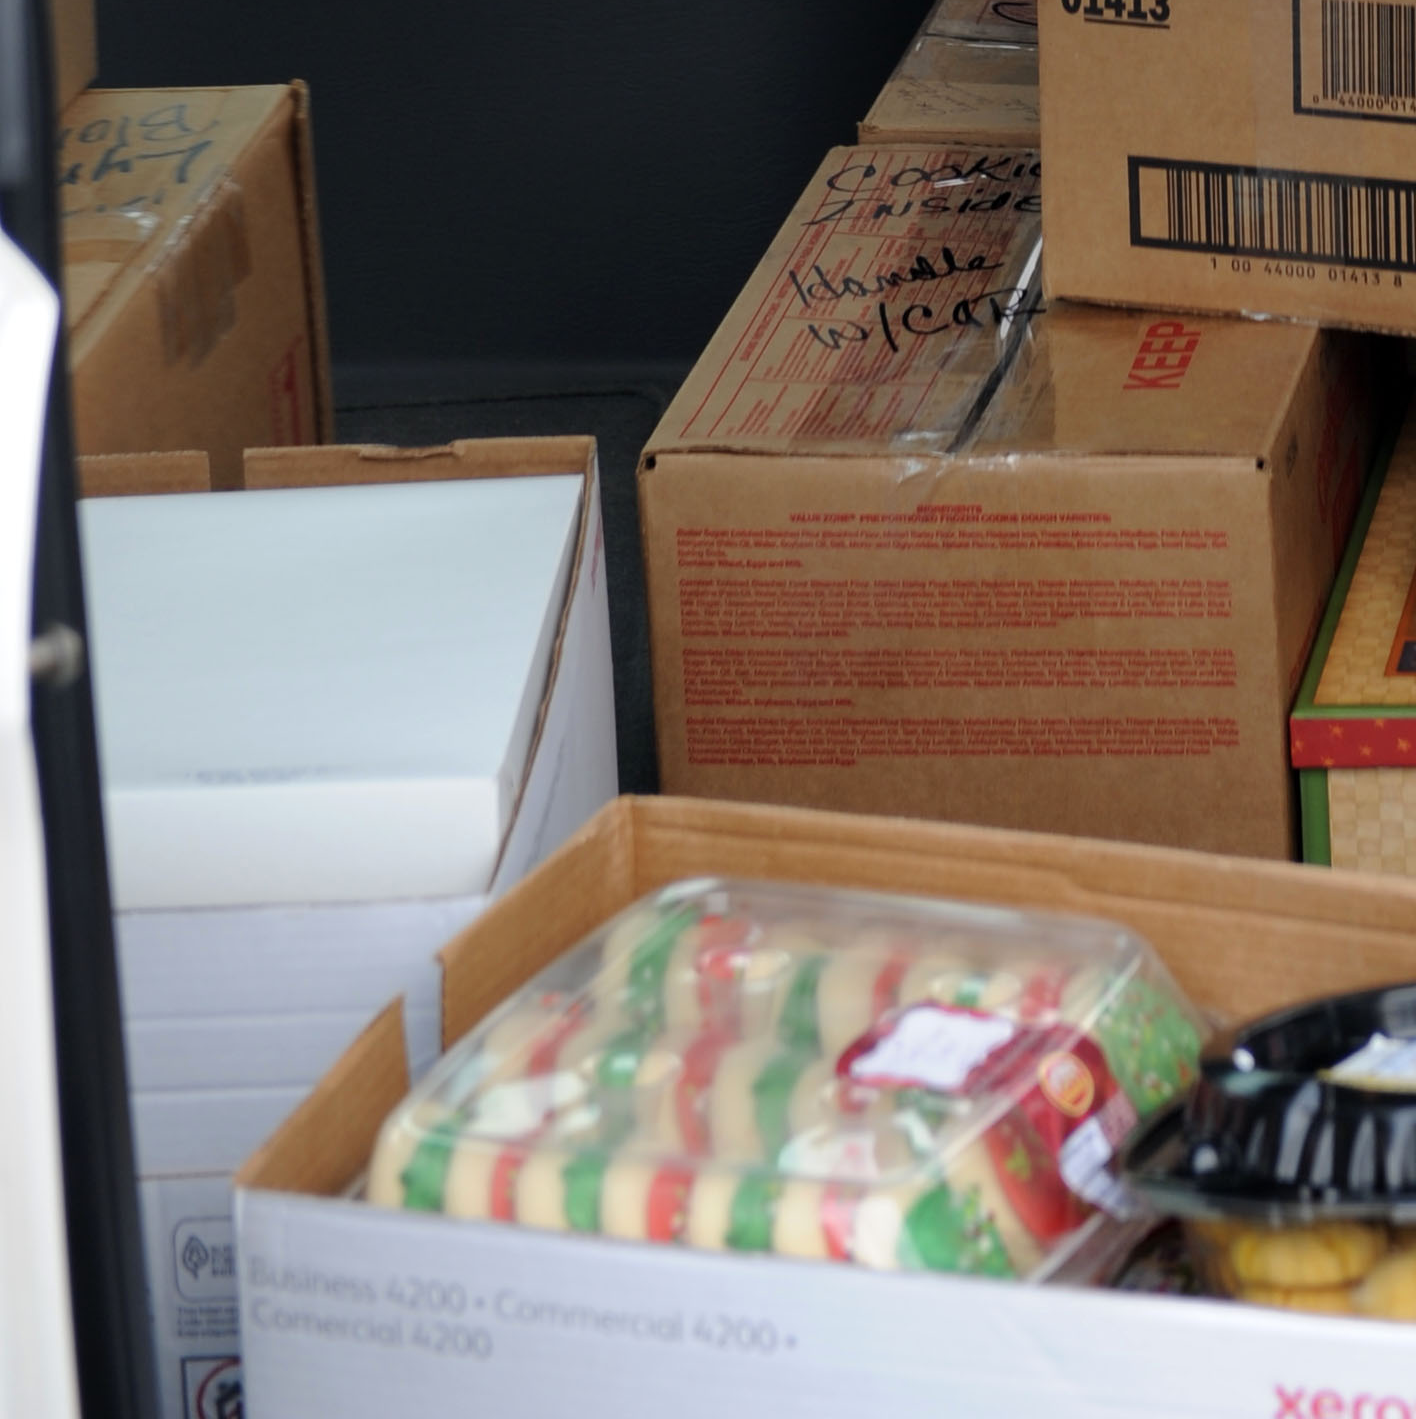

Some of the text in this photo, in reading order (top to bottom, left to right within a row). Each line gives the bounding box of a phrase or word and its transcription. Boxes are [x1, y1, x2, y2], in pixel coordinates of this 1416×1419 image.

[1338, 95, 1385, 112] 44000
[1210, 257, 1403, 288] 1 00 44000 01413 8
[1122, 320, 1202, 390] KEEP
[247, 1257, 378, 1305] Business
[385, 1276, 468, 1316] 4200
[493, 1289, 685, 1341] Commercial
[692, 1310, 780, 1354] 4200
[248, 1296, 405, 1346] Comercial
[410, 1317, 495, 1361] 4200
